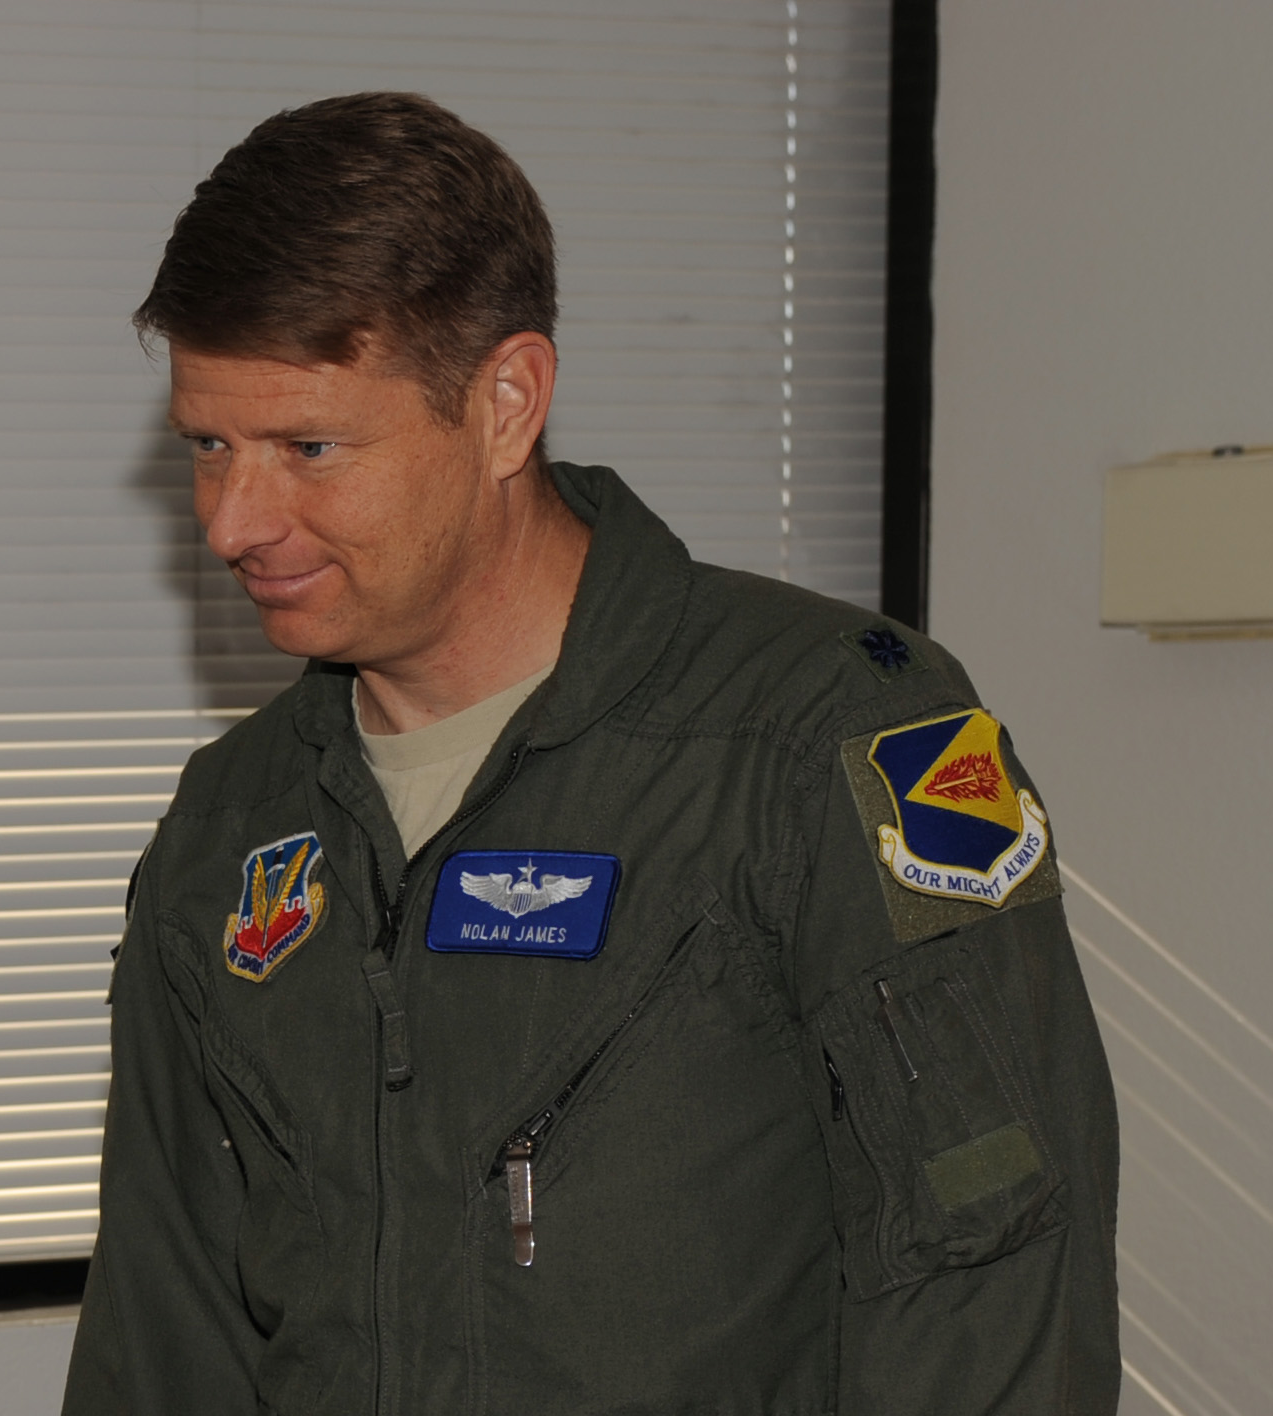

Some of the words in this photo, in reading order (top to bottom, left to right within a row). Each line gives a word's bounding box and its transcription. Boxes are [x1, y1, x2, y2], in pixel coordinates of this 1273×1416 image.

[904, 863, 941, 888] OUR
[947, 875, 1002, 899] MIGHT
[1003, 833, 1040, 882] ALWAYS
[266, 913, 311, 963] COMMAND
[460, 923, 510, 940] NOLAN
[515, 926, 567, 943] JAMES
